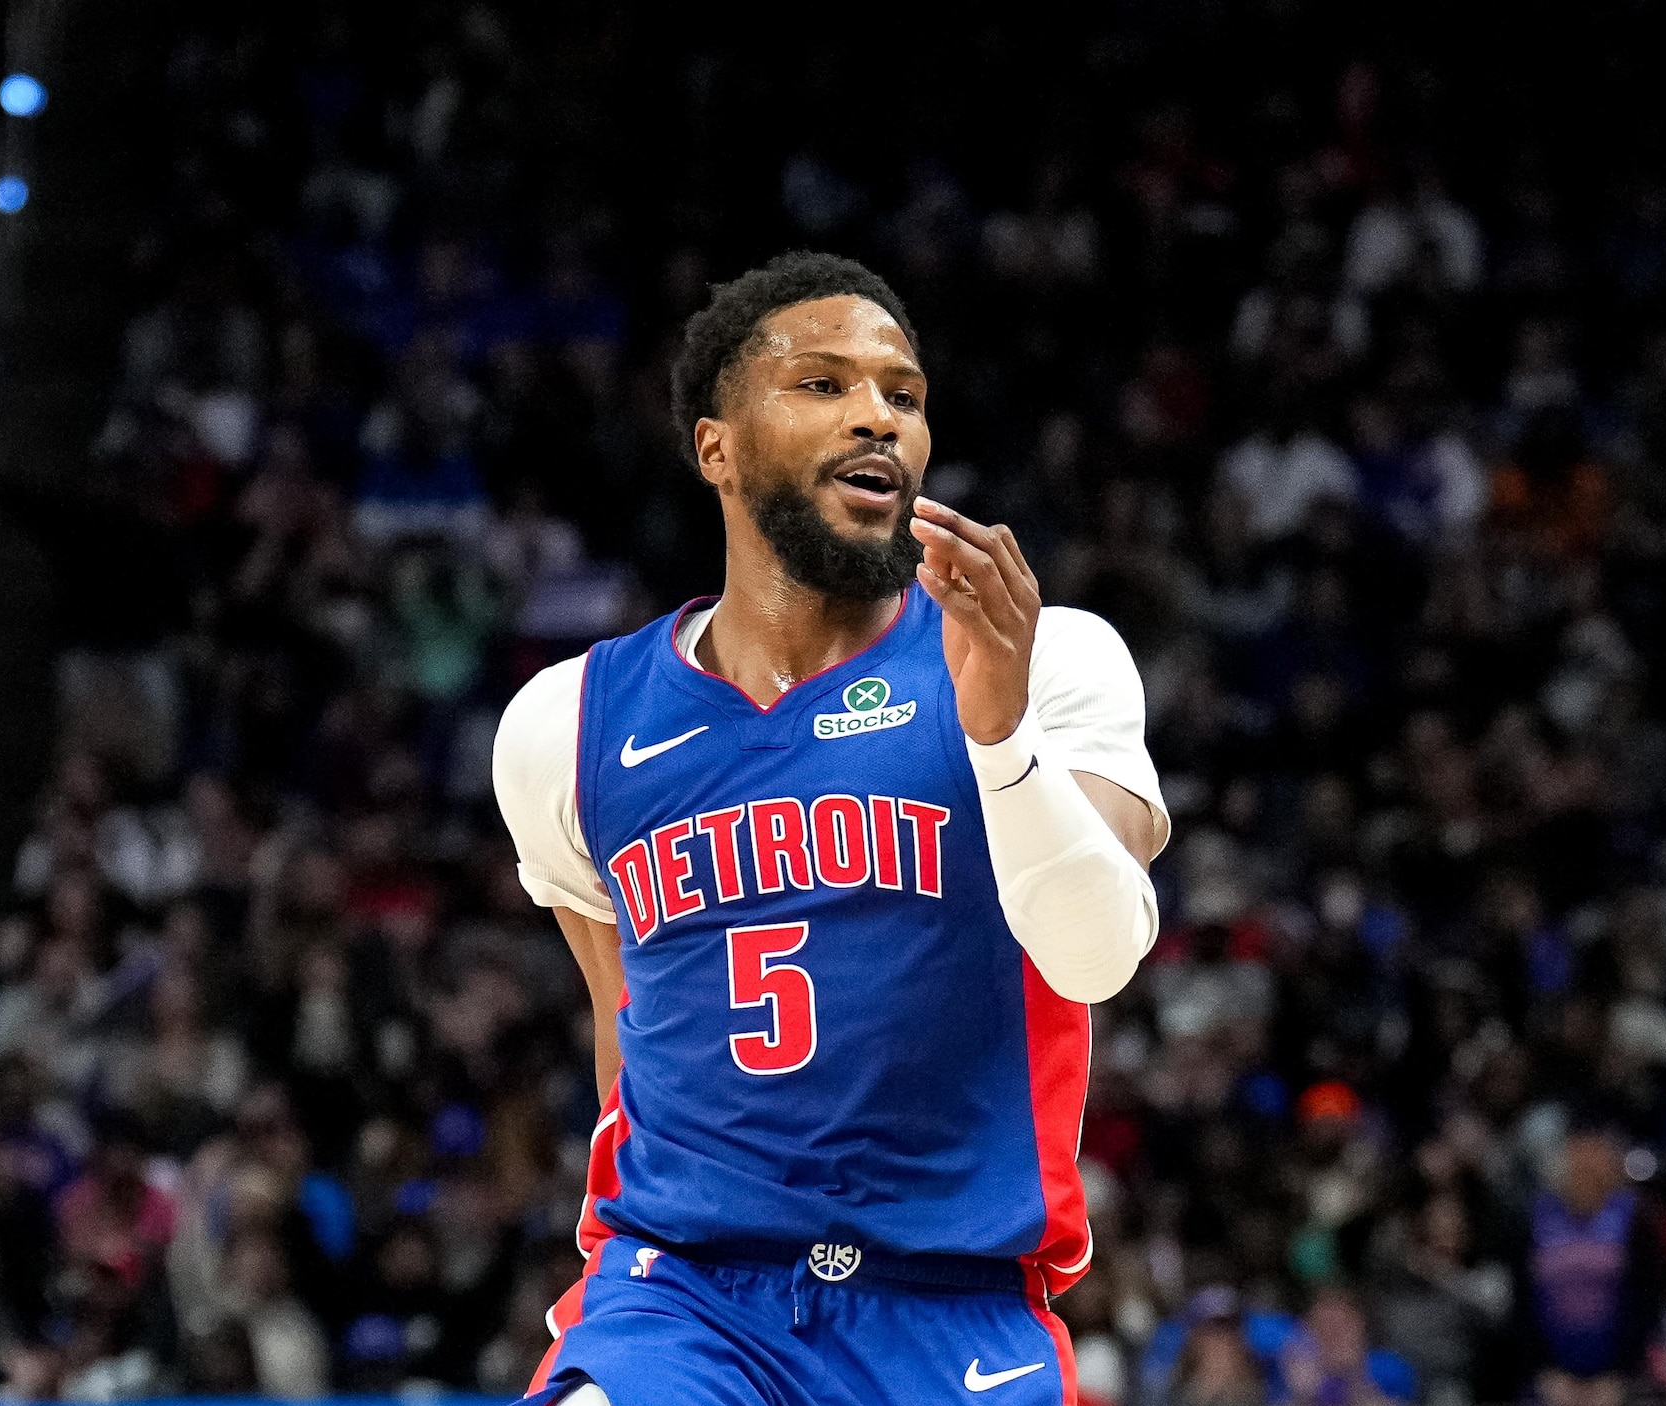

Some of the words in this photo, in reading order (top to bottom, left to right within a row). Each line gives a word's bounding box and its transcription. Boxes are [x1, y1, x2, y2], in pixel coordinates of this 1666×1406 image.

[818, 703, 913, 736] StockX
[608, 793, 951, 944] DETROIT
[726, 920, 818, 1076] 5
